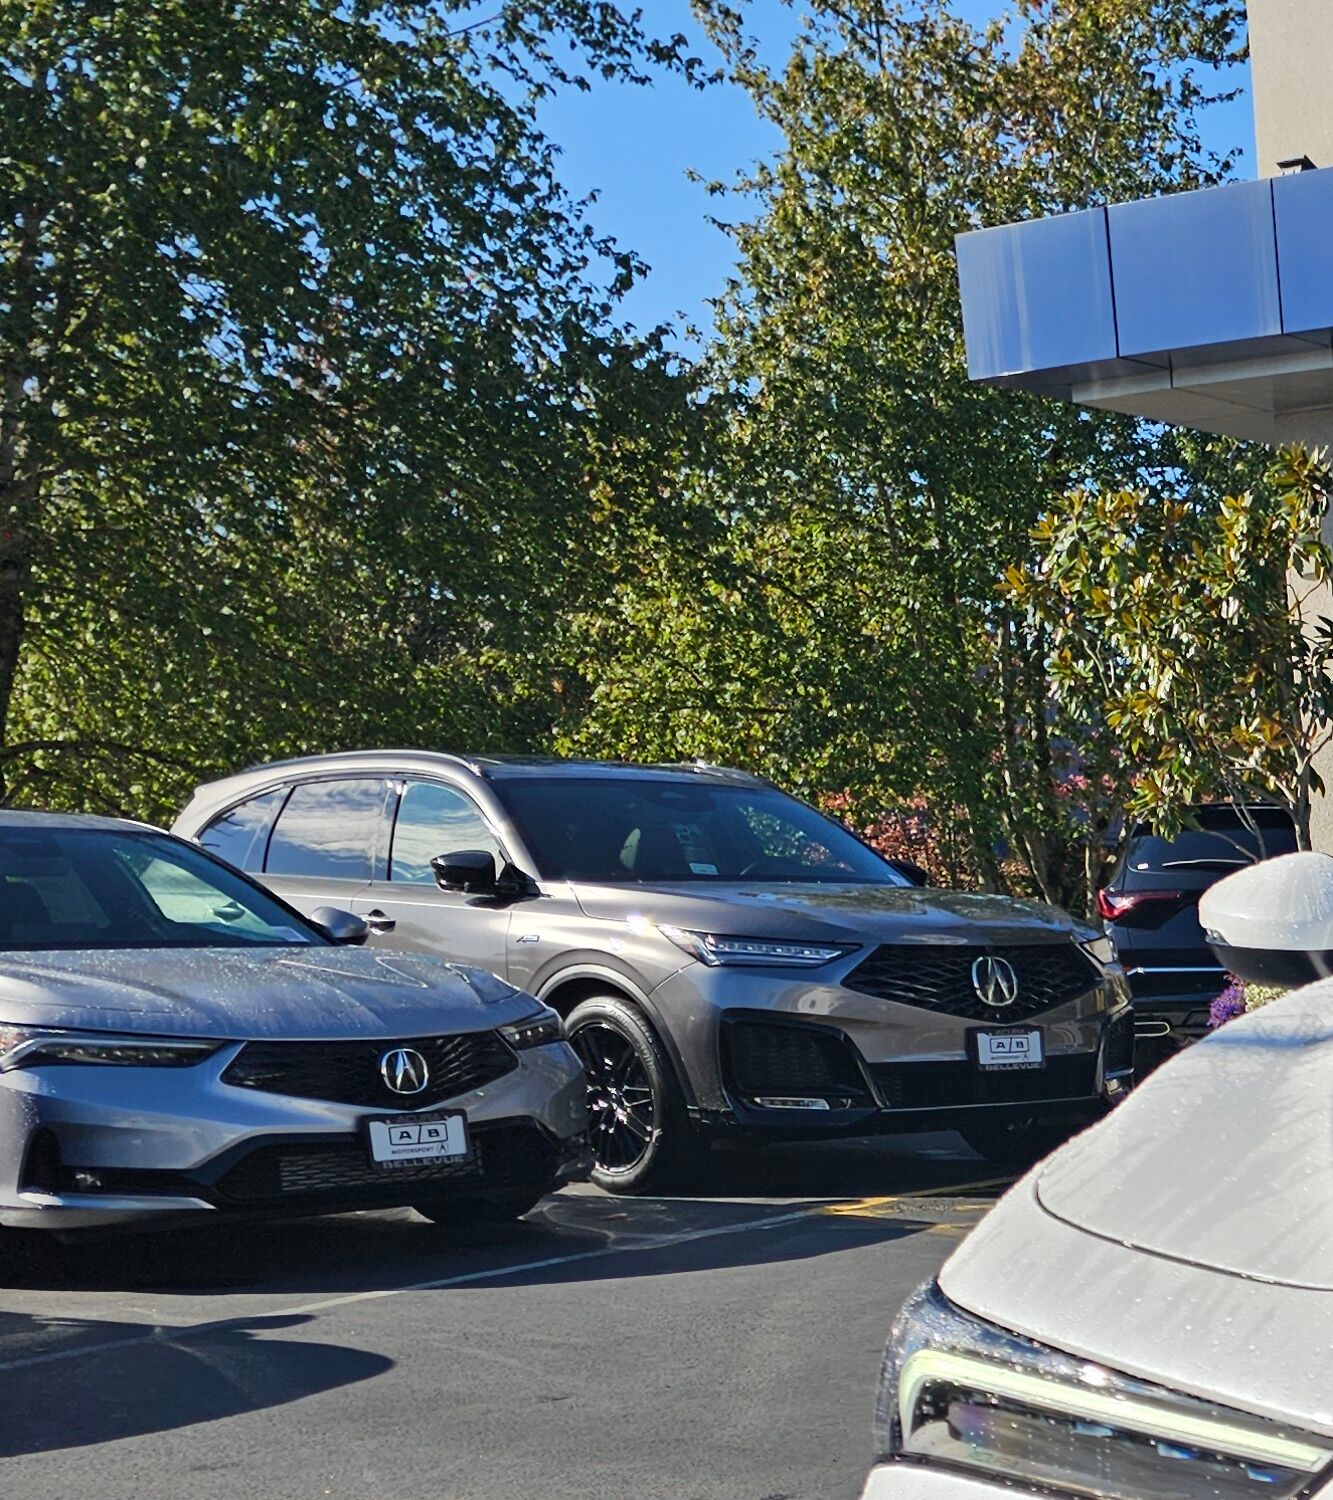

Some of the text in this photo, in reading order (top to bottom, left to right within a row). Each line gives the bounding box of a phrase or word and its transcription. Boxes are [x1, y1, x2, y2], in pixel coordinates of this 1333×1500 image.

[985, 1063, 1041, 1071] BELLEVUE
[391, 1146, 434, 1155] MOTORSPORT
[382, 1155, 465, 1169] BELLEVUE
